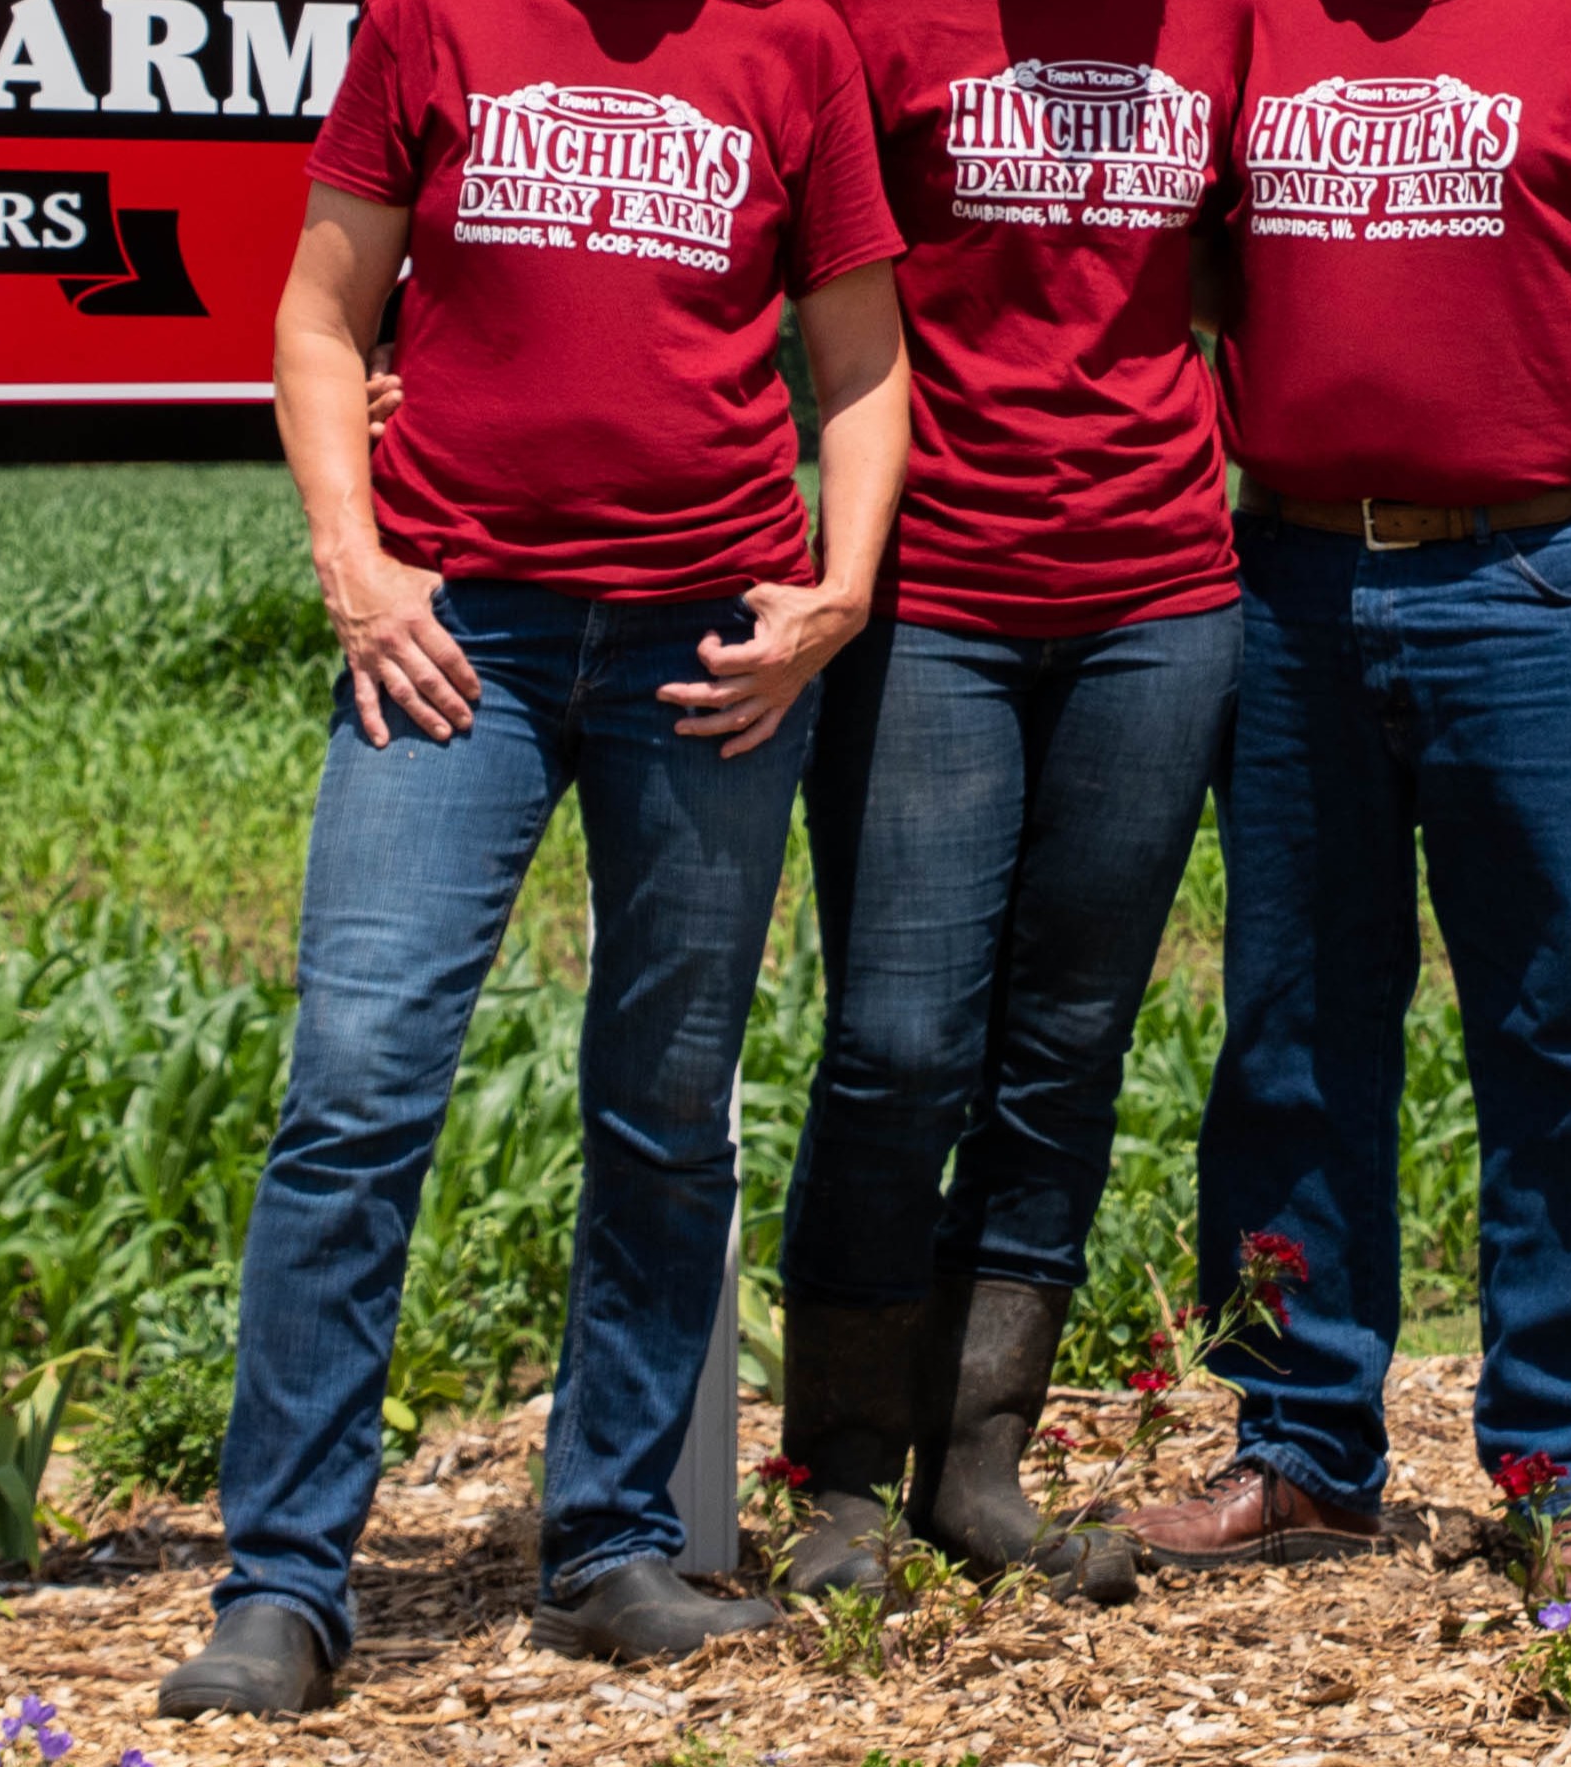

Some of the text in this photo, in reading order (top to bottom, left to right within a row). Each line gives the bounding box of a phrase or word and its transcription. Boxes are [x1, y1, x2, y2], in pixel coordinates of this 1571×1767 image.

[955, 159, 1205, 207] DAIRY FARM
[1251, 171, 1504, 215] DAIRY FARM
[458, 177, 732, 248] DAIRY FARM
[1364, 216, 1505, 241] 608-764-5090
[586, 232, 730, 274] 608-764-5090
